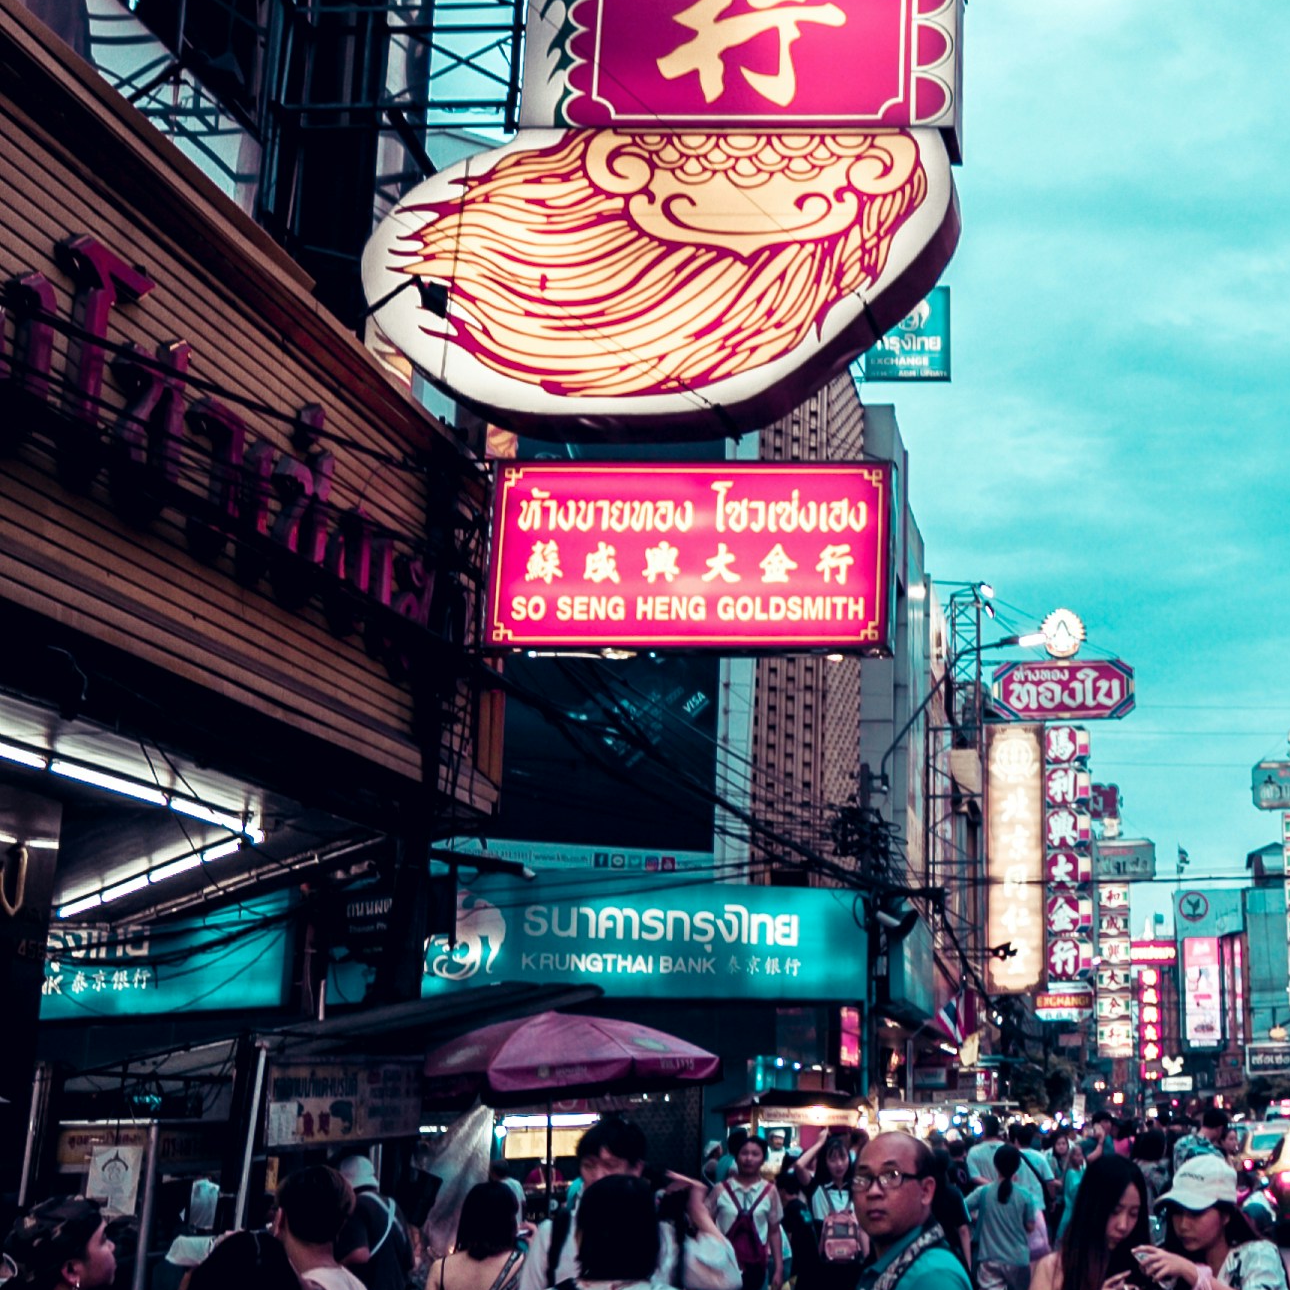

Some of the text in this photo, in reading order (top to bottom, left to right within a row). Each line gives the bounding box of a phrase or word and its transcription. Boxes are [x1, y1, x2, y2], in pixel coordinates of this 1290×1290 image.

[517, 481, 867, 533] ห้างขายทอง โซวเซ่งเฮง
[525, 539, 854, 585] 蘇成興大金行
[511, 596, 865, 621] SO SENG HENG GOLDSMITH
[682, 690, 706, 714] VISA
[1008, 667, 1121, 710] ทองใบ
[522, 903, 799, 954] ธนาคารกรุงไทย
[521, 952, 716, 975] KRUNGTHAI BANK
